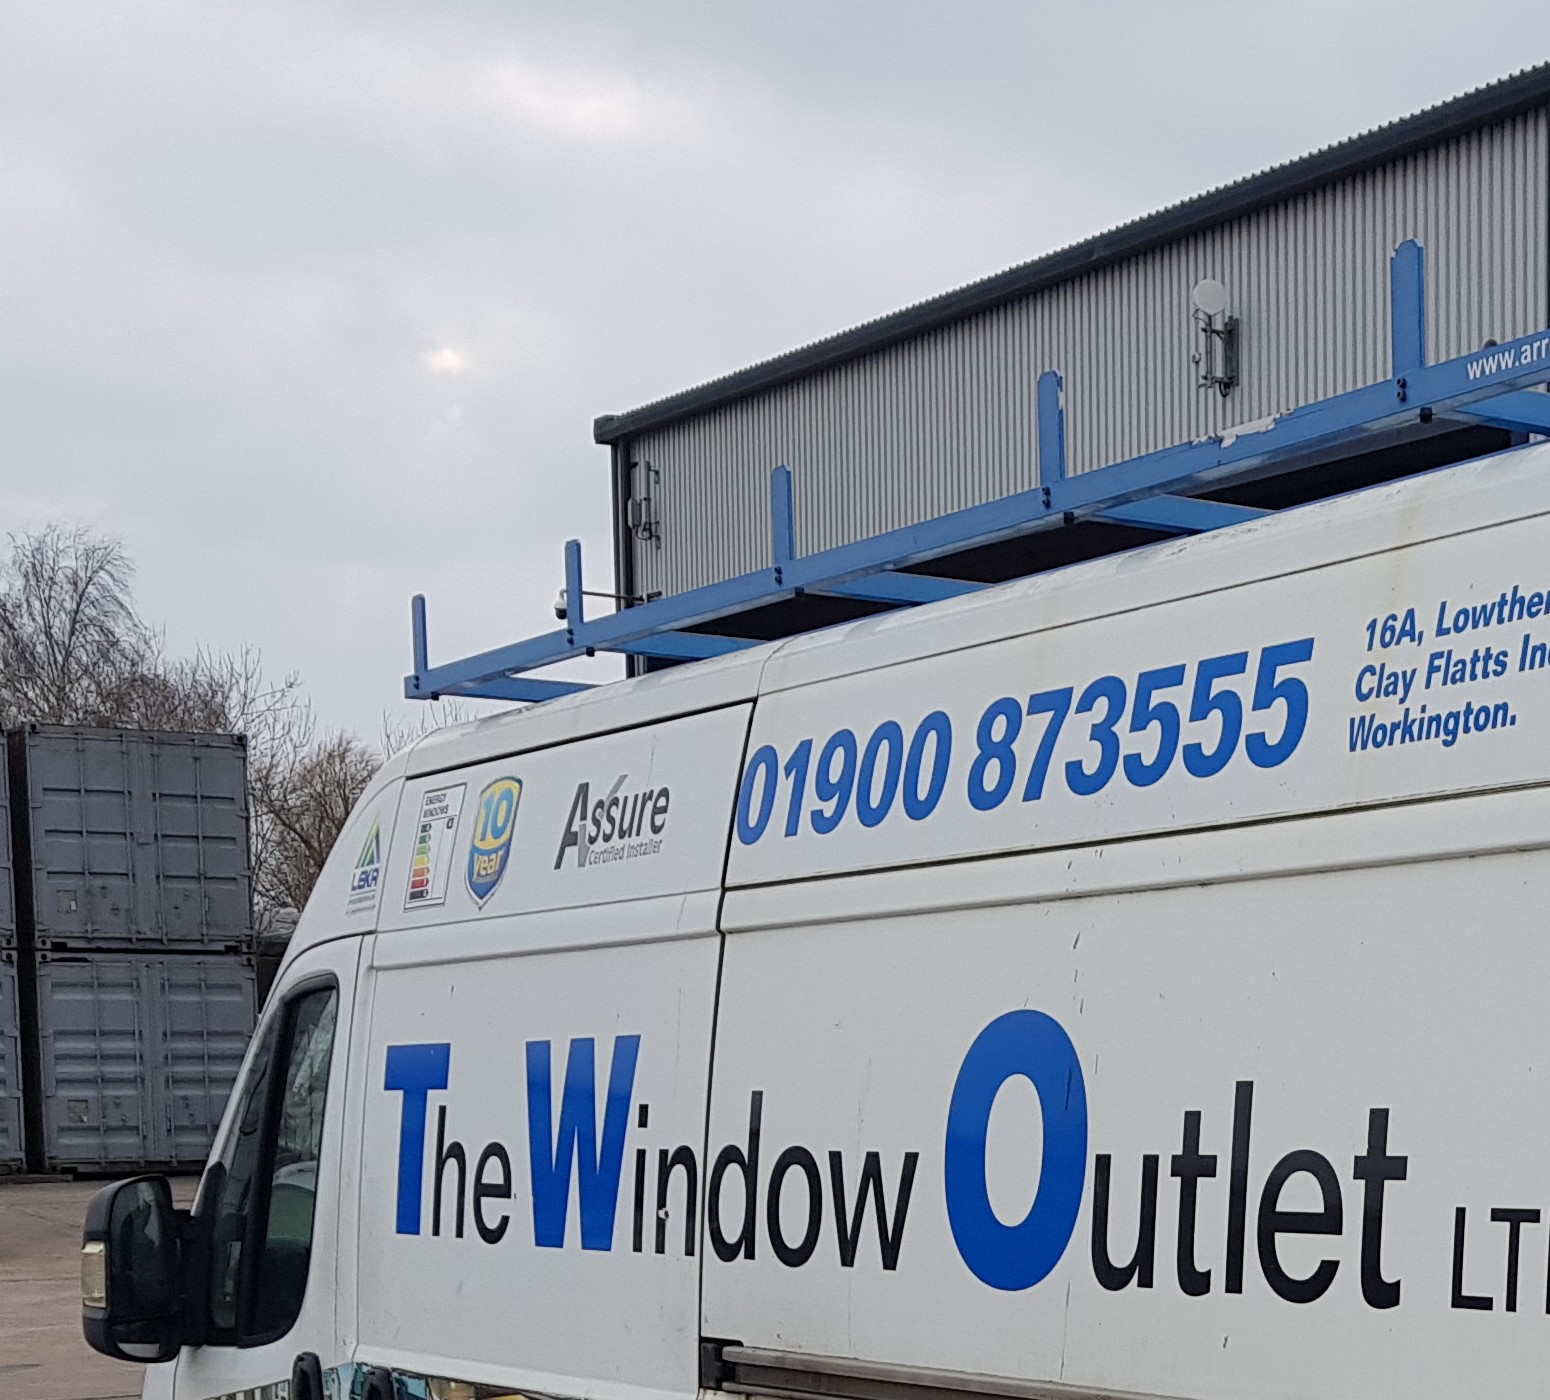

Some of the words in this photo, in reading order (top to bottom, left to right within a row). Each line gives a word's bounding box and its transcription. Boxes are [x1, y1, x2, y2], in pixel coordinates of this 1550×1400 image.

[1365, 607, 1424, 652] 16A,
[1355, 662, 1417, 704] Clay
[1424, 646, 1508, 689] Flatts
[736, 710, 952, 846] 01900
[966, 637, 1315, 812] 873555
[1349, 701, 1517, 753] Workington.
[480, 787, 514, 842] 10
[553, 782, 670, 870] Assure
[383, 1042, 512, 1245] The
[524, 1034, 919, 1271] Window
[945, 1008, 1408, 1310] Outlet
